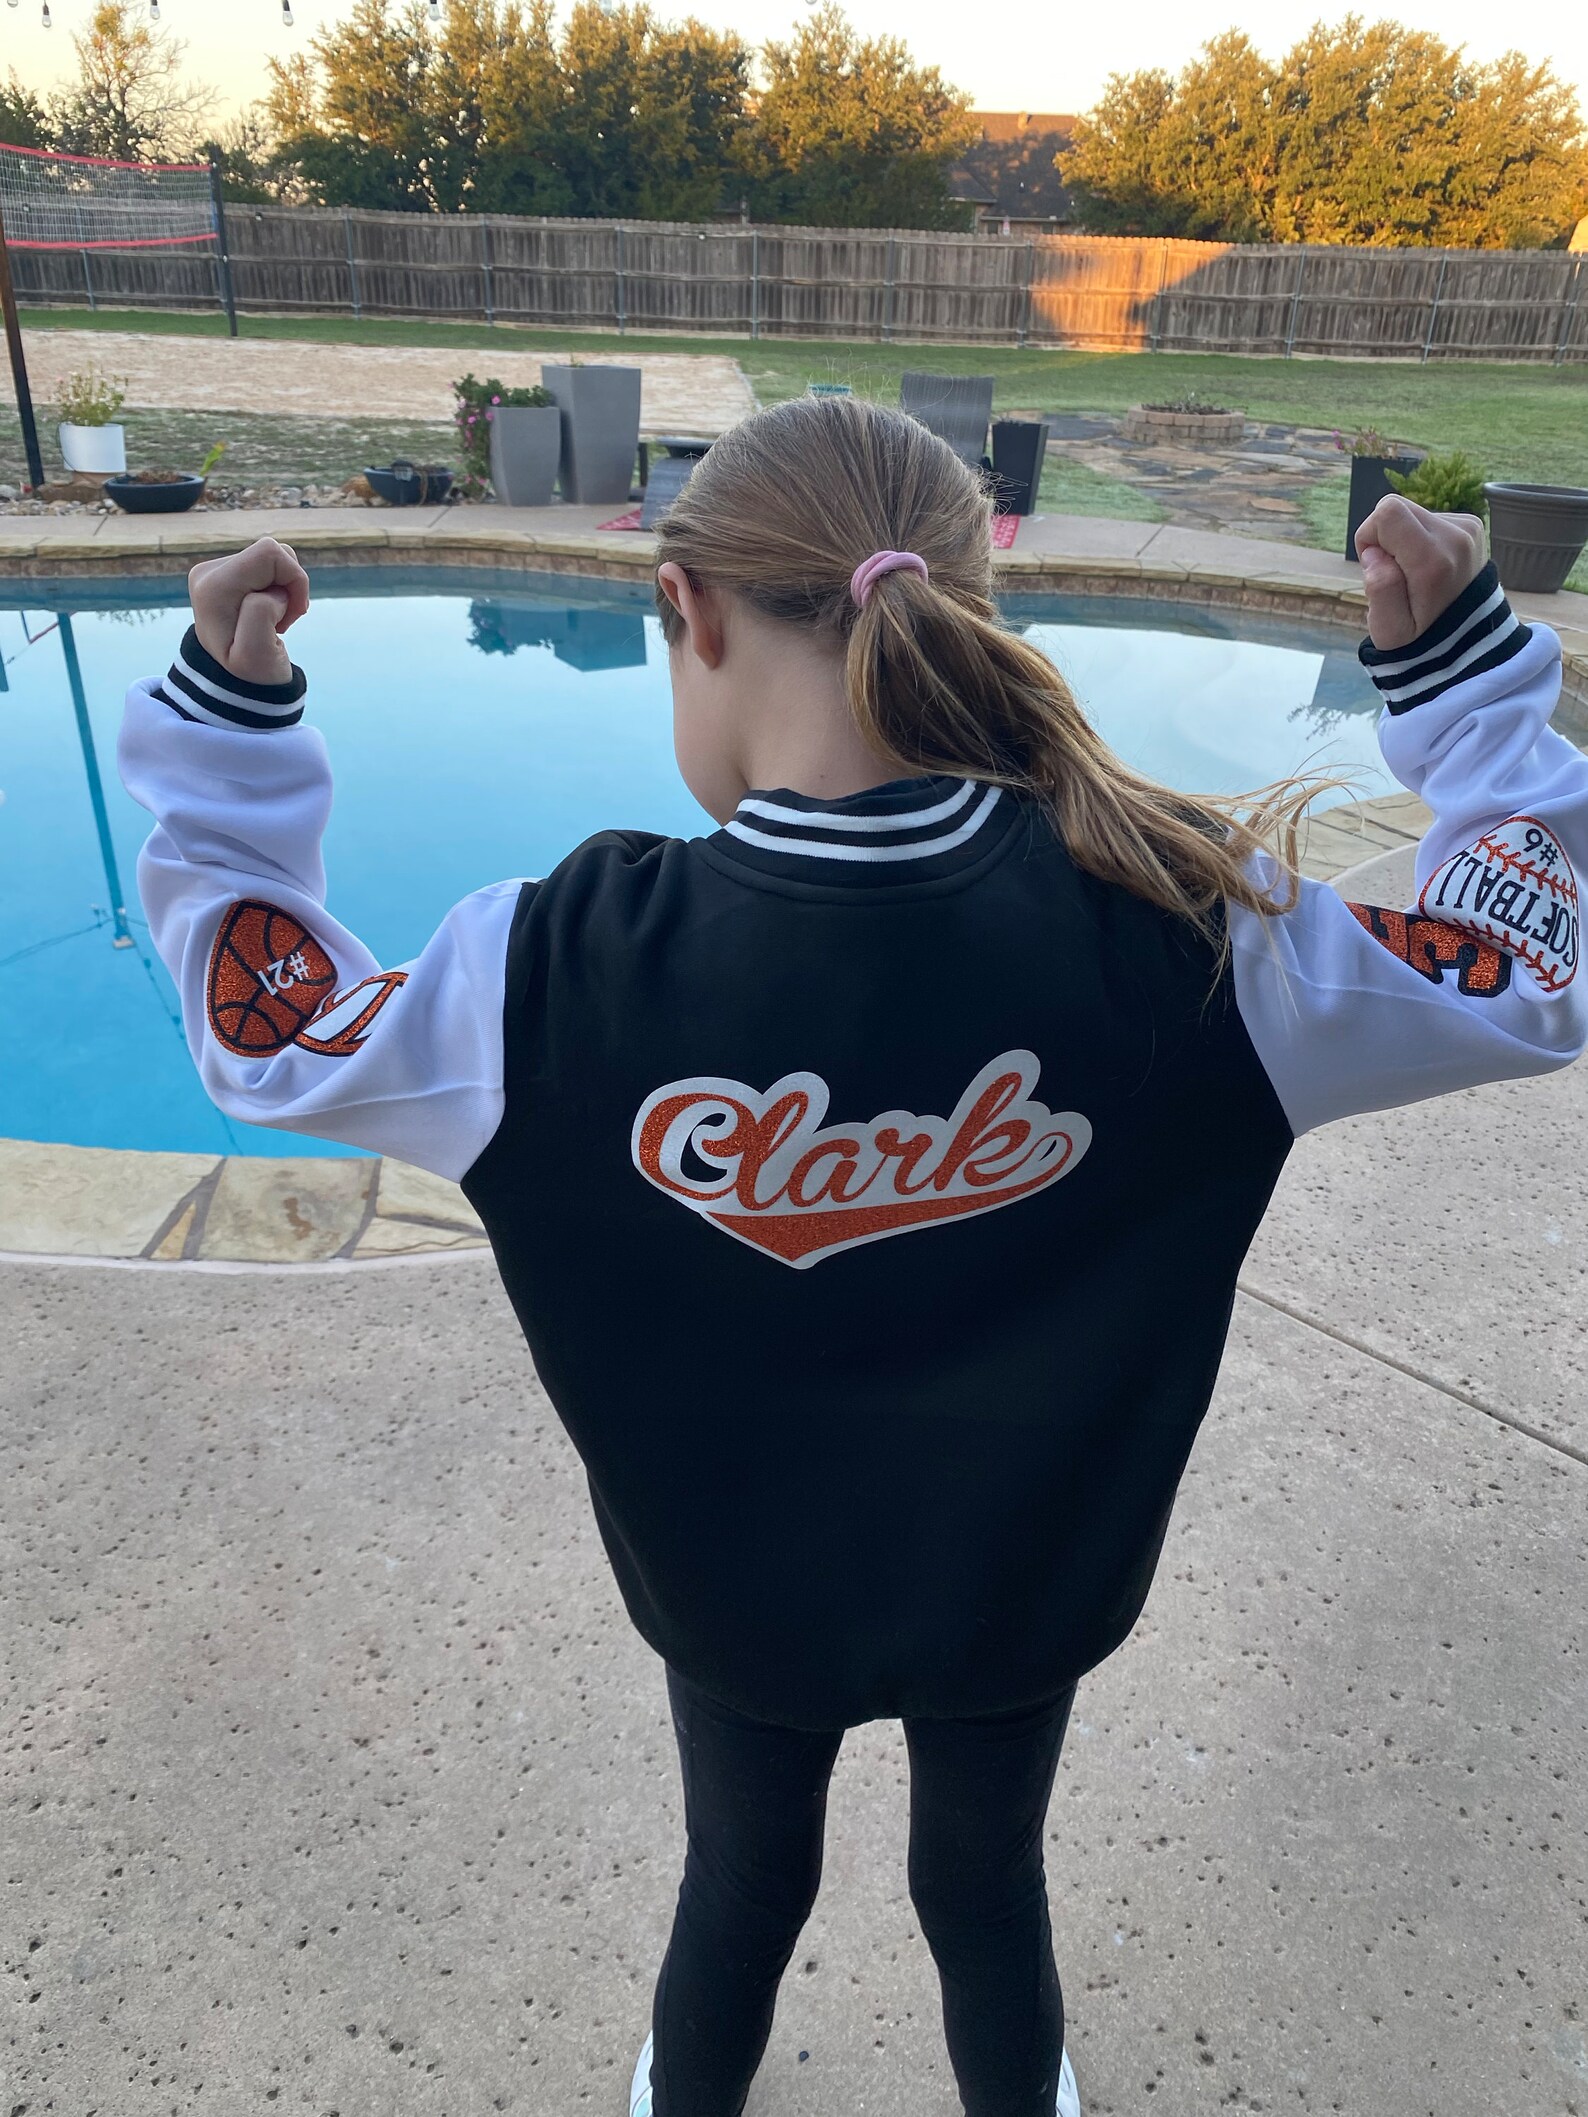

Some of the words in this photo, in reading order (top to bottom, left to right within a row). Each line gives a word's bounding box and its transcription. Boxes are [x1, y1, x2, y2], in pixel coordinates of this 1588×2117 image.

[1435, 851, 1578, 968] SOFTBALL
[258, 951, 310, 996] #21
[636, 1066, 1077, 1211] Clark
